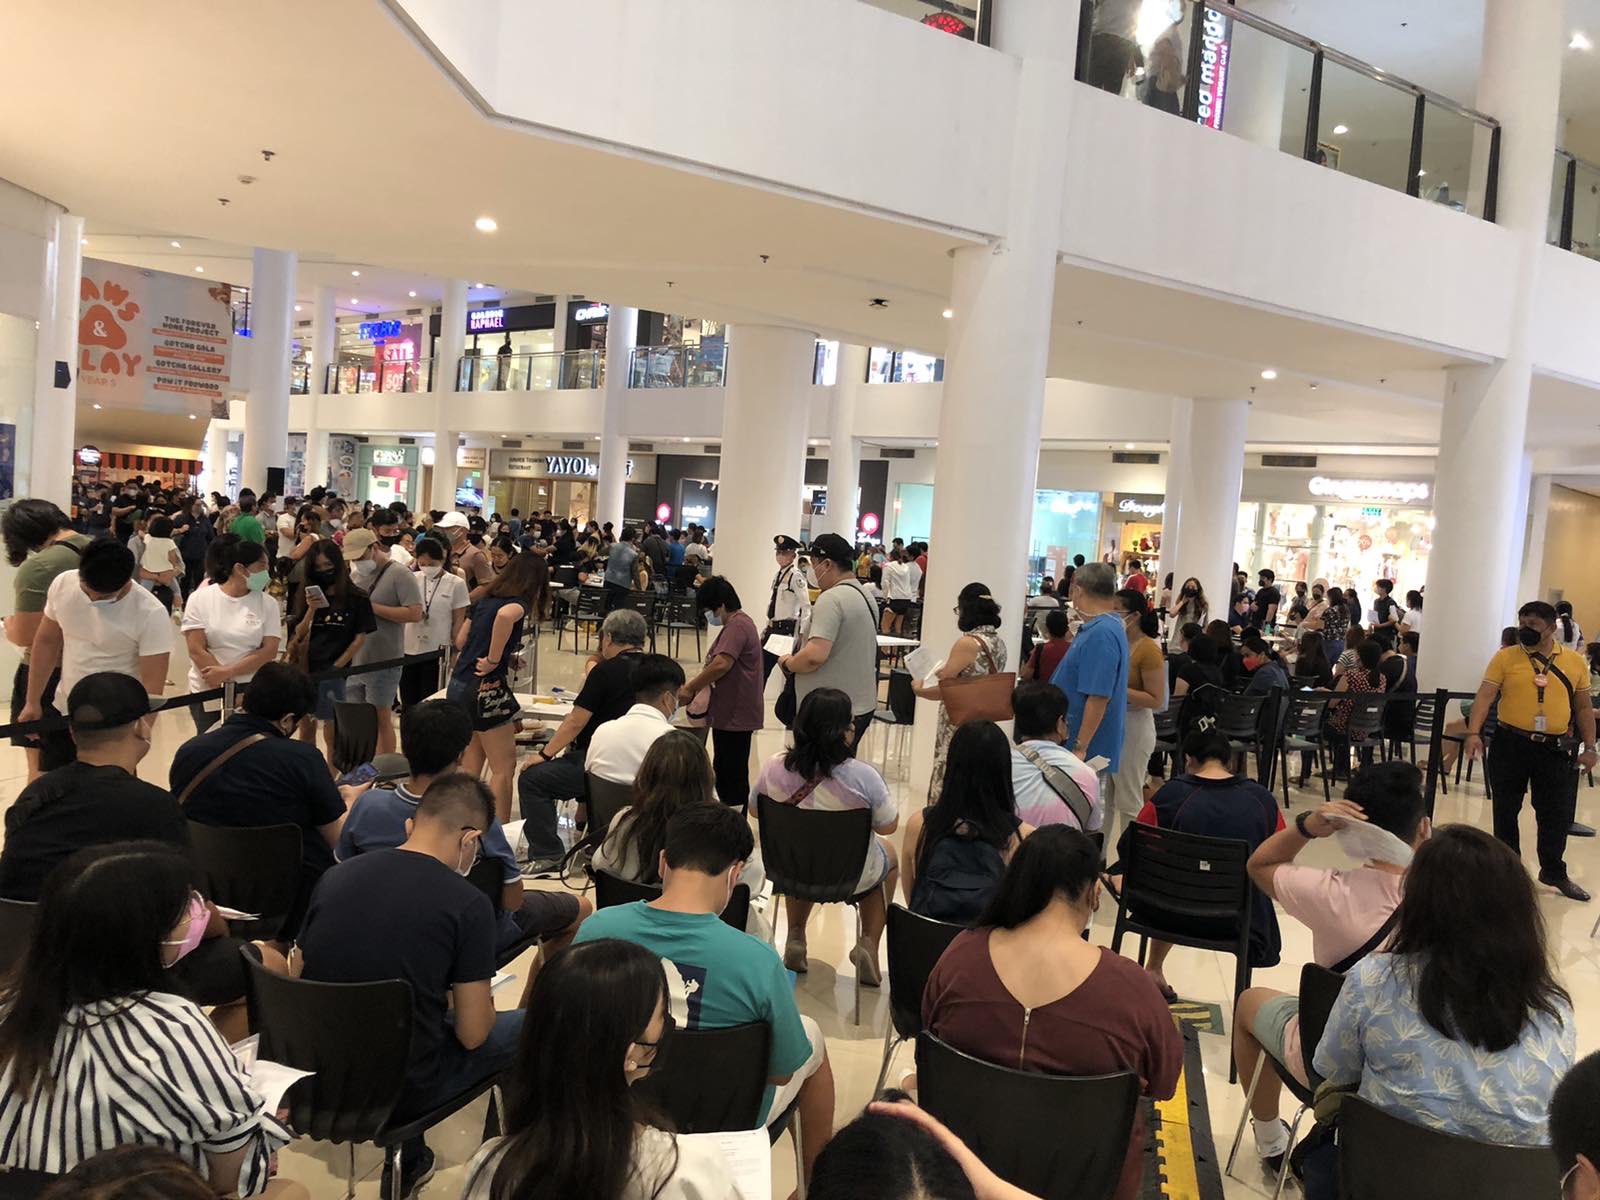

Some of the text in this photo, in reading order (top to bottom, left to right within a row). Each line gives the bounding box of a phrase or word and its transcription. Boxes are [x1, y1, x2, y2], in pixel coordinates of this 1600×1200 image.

[93, 320, 107, 337] &
[182, 318, 216, 329] FOREVER
[470, 317, 504, 330] RAPHAEL
[185, 326, 219, 336] PROJECT
[81, 349, 142, 377] LAY
[187, 363, 222, 375] GALLERY
[545, 455, 589, 476] YAYOI
